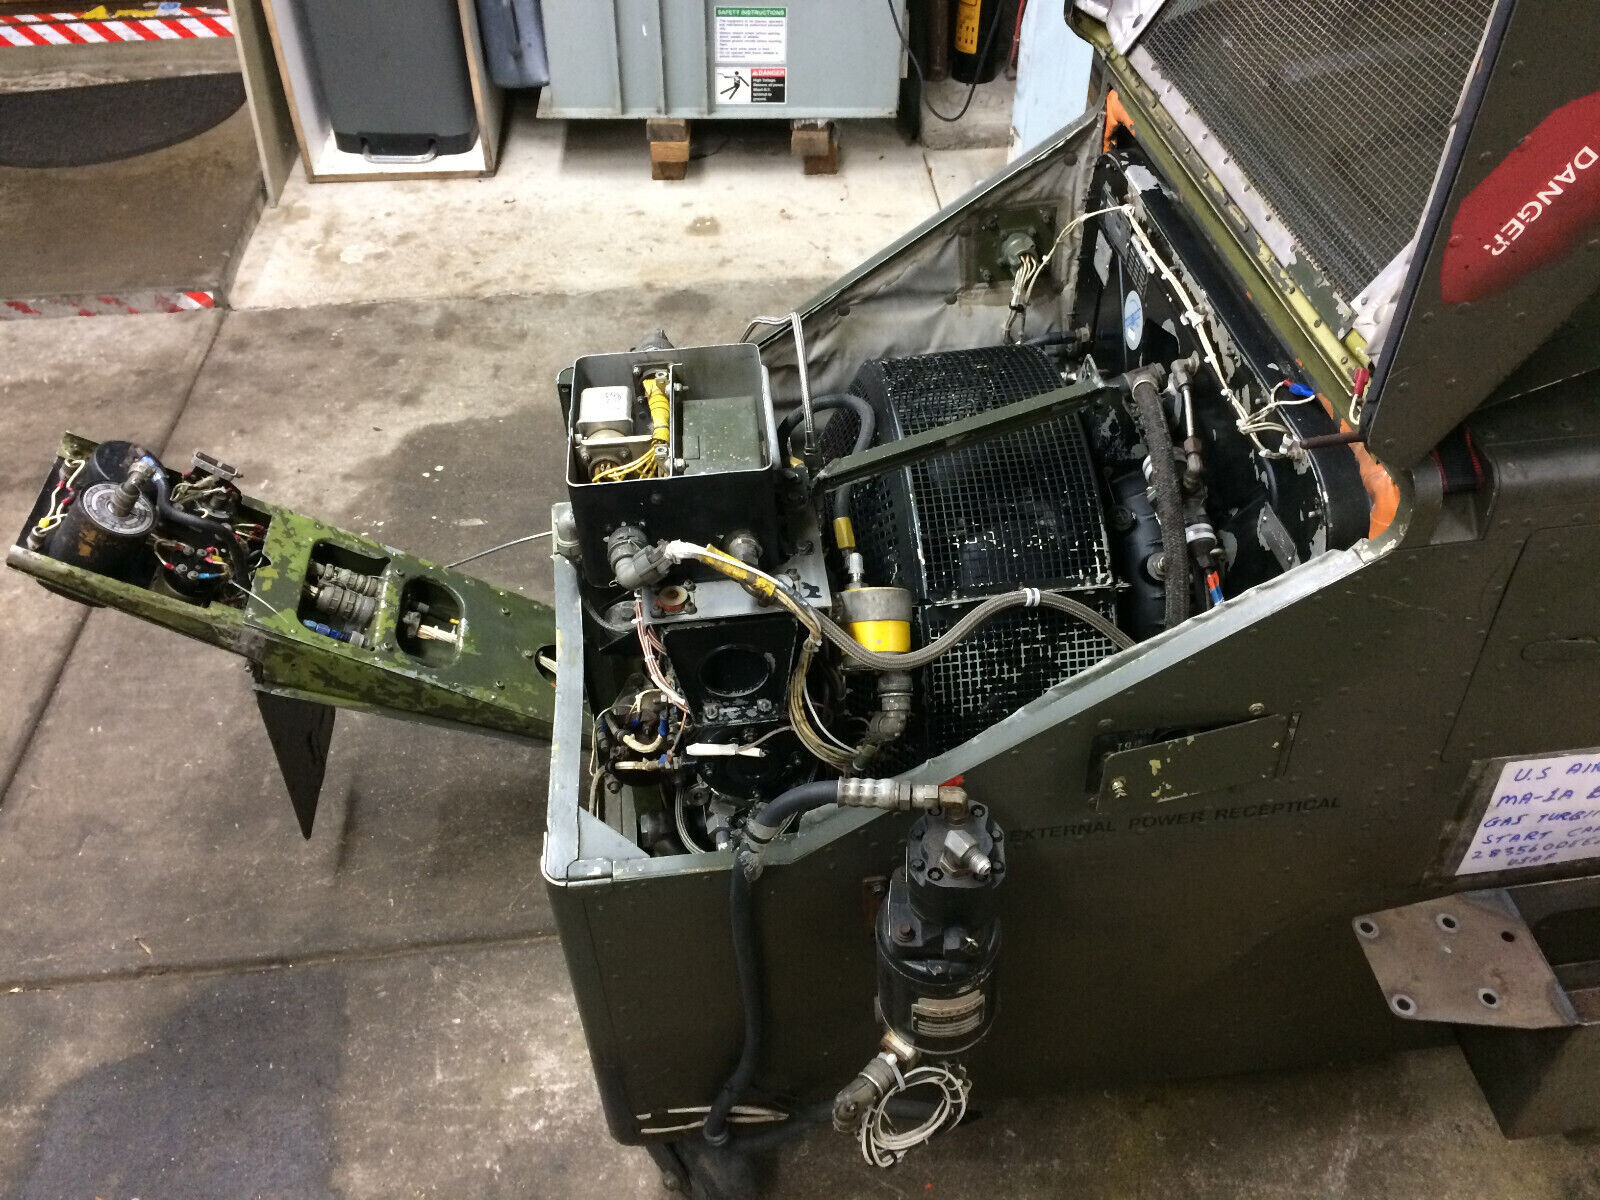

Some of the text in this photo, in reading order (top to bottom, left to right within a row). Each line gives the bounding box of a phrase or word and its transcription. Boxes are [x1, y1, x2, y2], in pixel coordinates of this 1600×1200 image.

[1483, 145, 1600, 256] DANGER
[1008, 796, 1343, 842] EXTERNAL POWER RECEPTICAL
[1484, 813, 1530, 828] GAS
[1482, 830, 1552, 845] START
